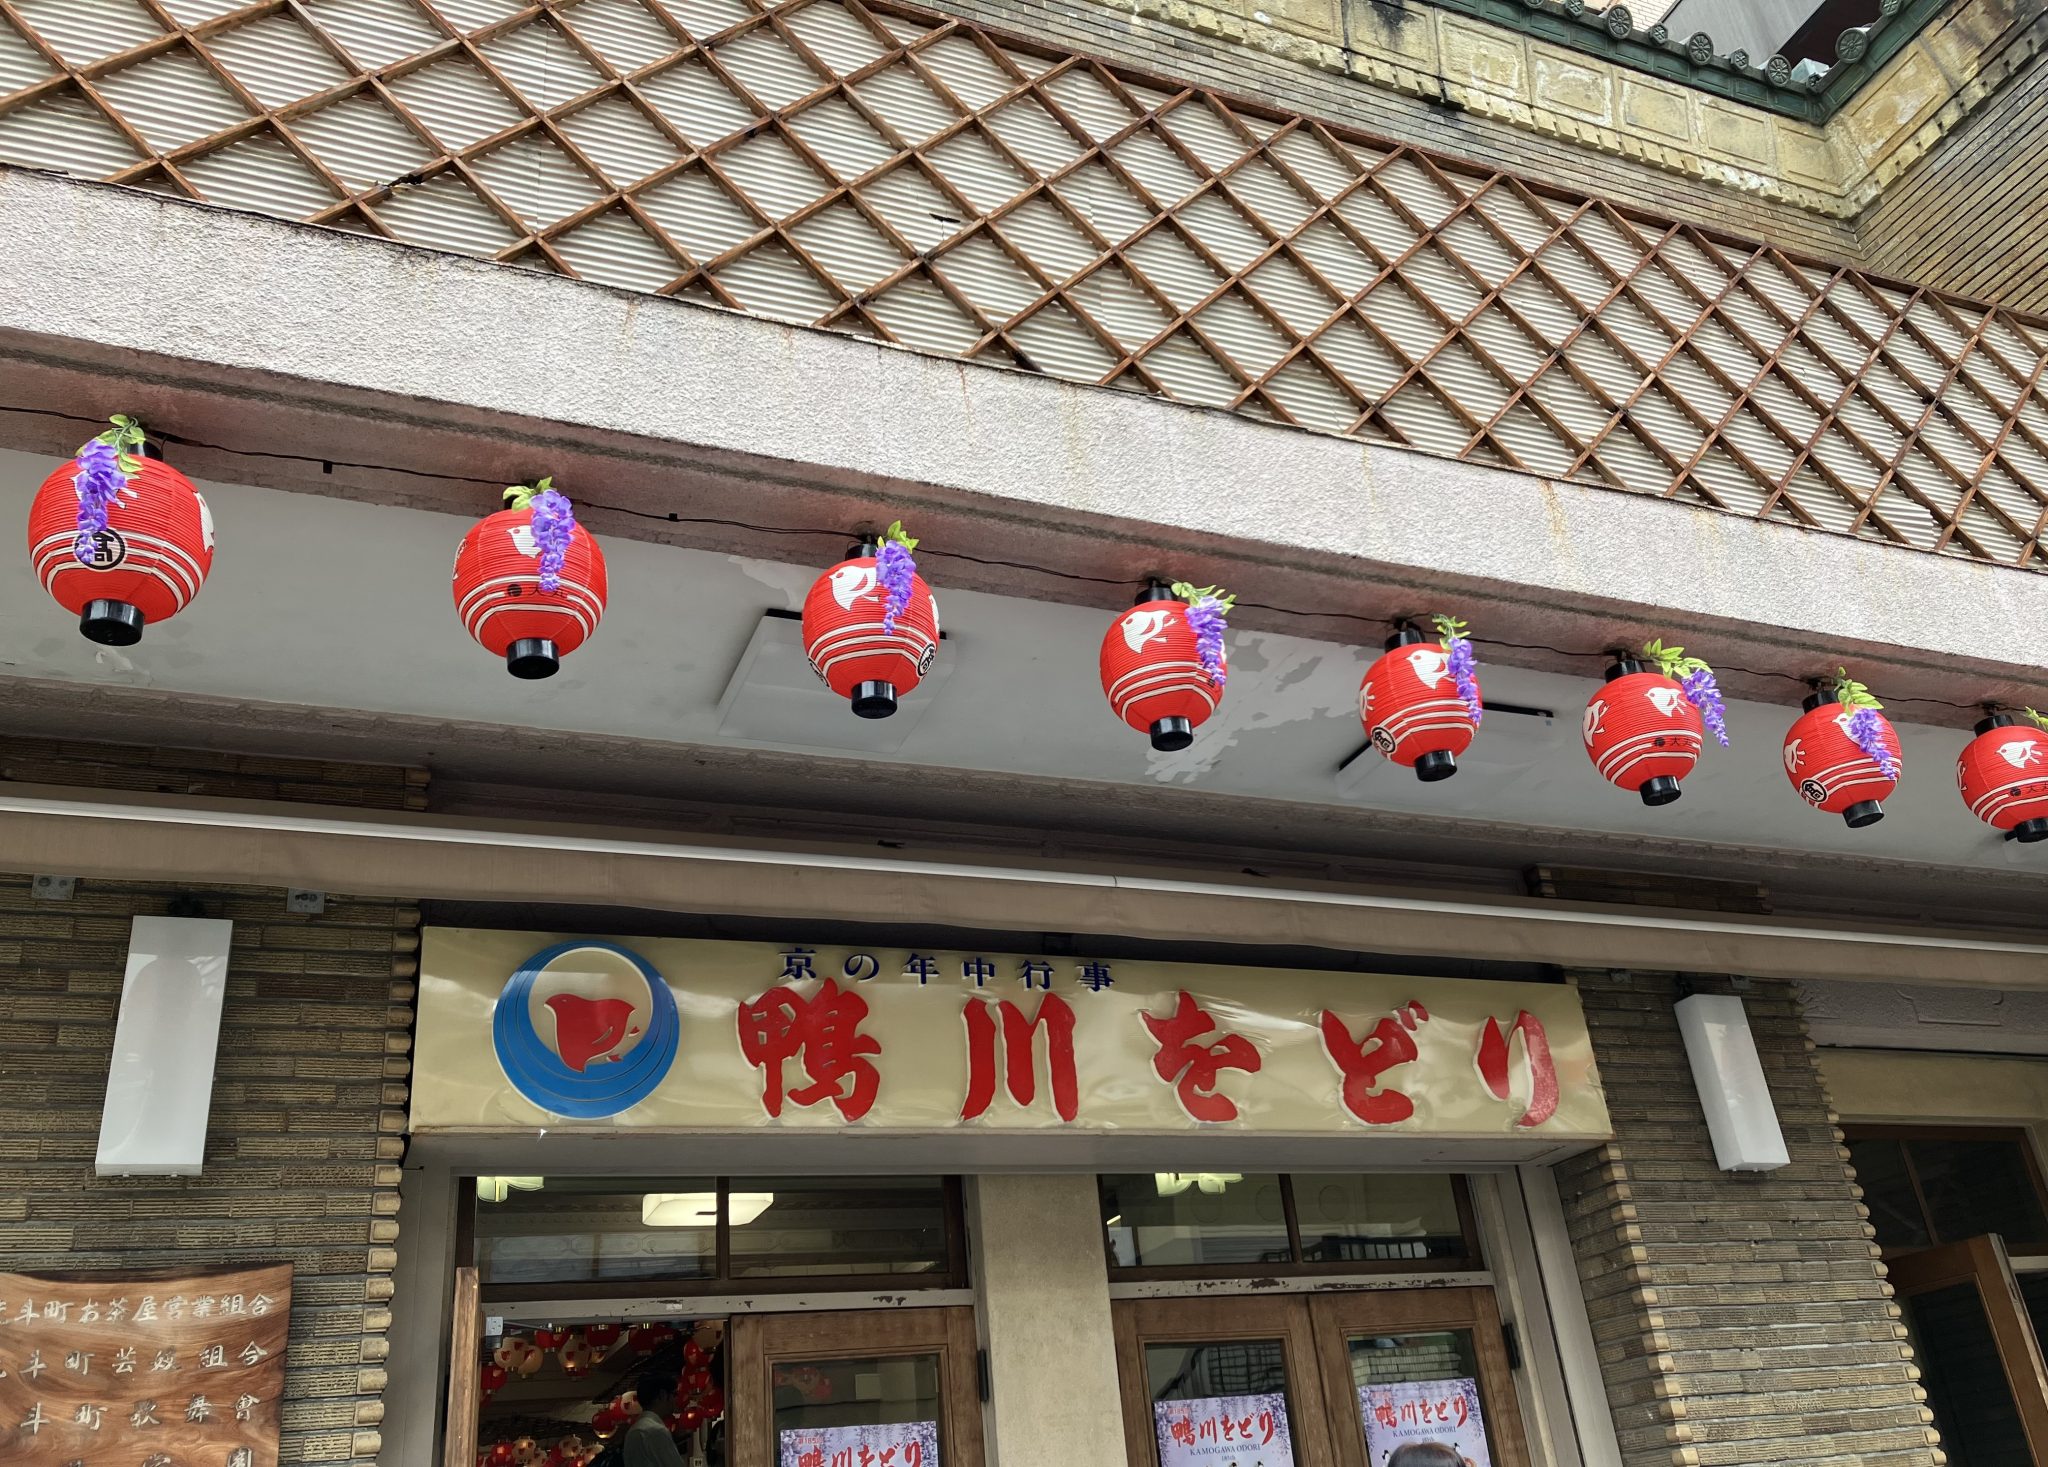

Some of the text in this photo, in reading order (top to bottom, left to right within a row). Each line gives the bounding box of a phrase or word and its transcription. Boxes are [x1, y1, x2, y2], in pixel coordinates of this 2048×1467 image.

[778, 947, 1115, 993] 京の年中行事
[737, 977, 1559, 1130] 鴨川をどり
[0, 1340, 268, 1379] 斗町芸妓組合
[1170, 1409, 1274, 1448] 鴨川をどり
[1375, 1395, 1468, 1430] 鴨川をどり
[1190, 1443, 1261, 1456] KAMOGAWA ODORI
[1392, 1427, 1434, 1438] KAMOGAWA
